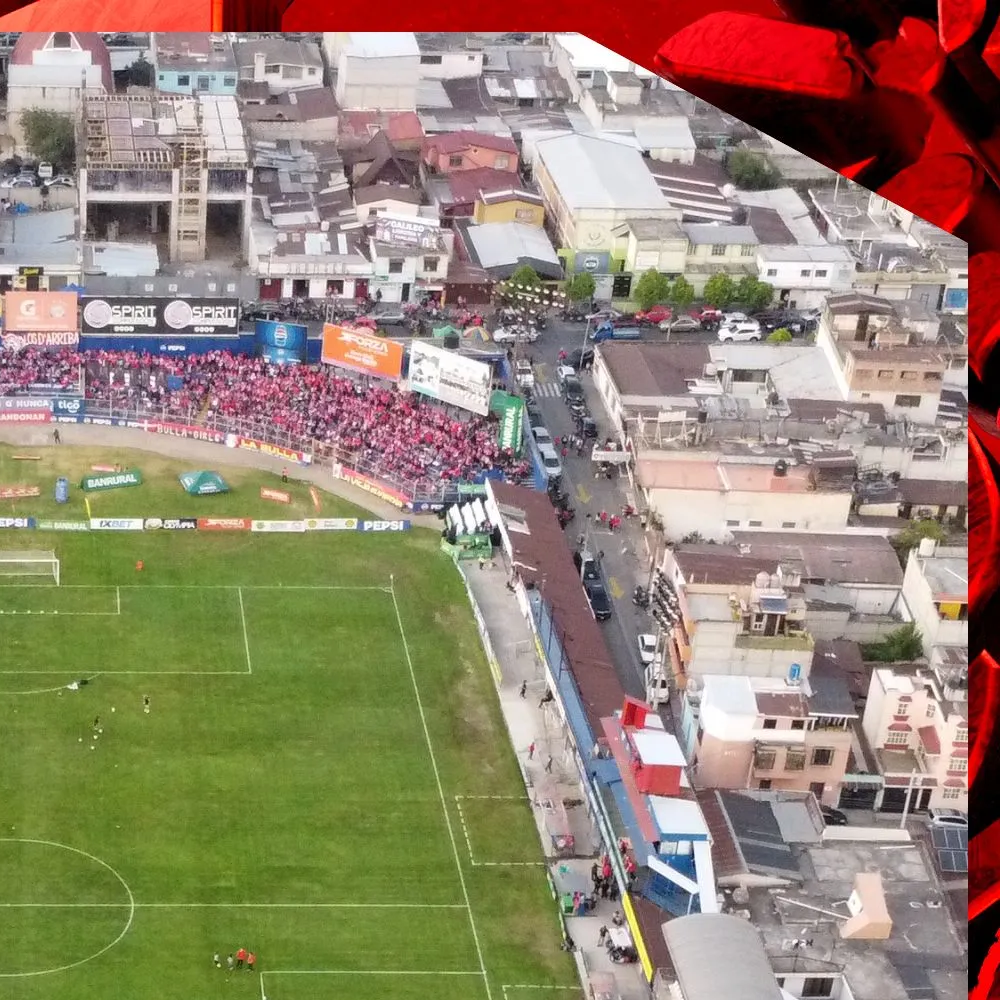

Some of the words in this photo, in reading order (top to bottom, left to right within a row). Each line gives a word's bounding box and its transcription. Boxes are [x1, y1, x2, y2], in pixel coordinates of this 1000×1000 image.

[112, 305, 156, 318] SPIRIT
[193, 306, 237, 319] SPIRIT
[58, 400, 80, 413] tigo
[87, 474, 137, 489] BANRURAL
[363, 520, 404, 531] PEPSI
